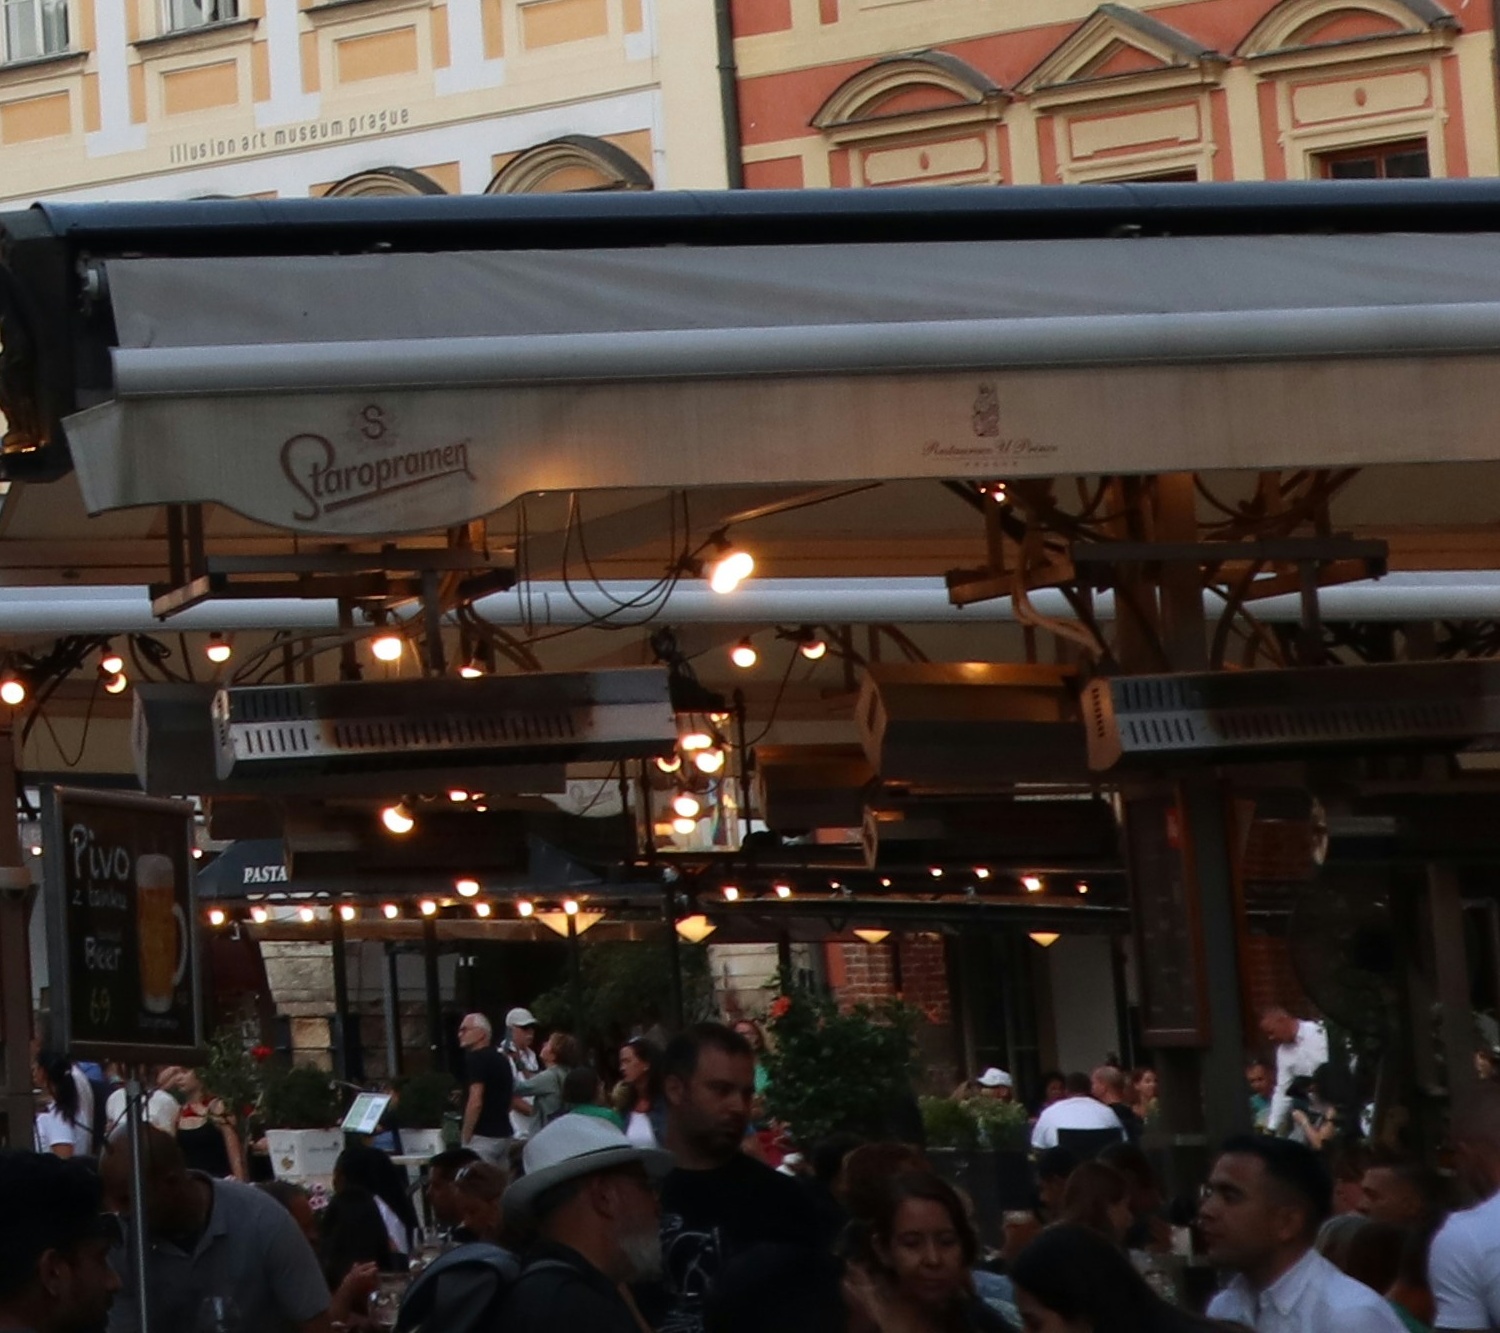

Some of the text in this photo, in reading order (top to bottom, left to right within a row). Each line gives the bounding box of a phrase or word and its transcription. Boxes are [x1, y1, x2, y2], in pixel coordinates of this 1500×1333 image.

[170, 108, 410, 164] illusion art museum prague
[280, 433, 474, 520] Staropramen
[69, 822, 130, 880] Pivo
[243, 865, 288, 884] PASTA
[84, 936, 122, 971] Beer
